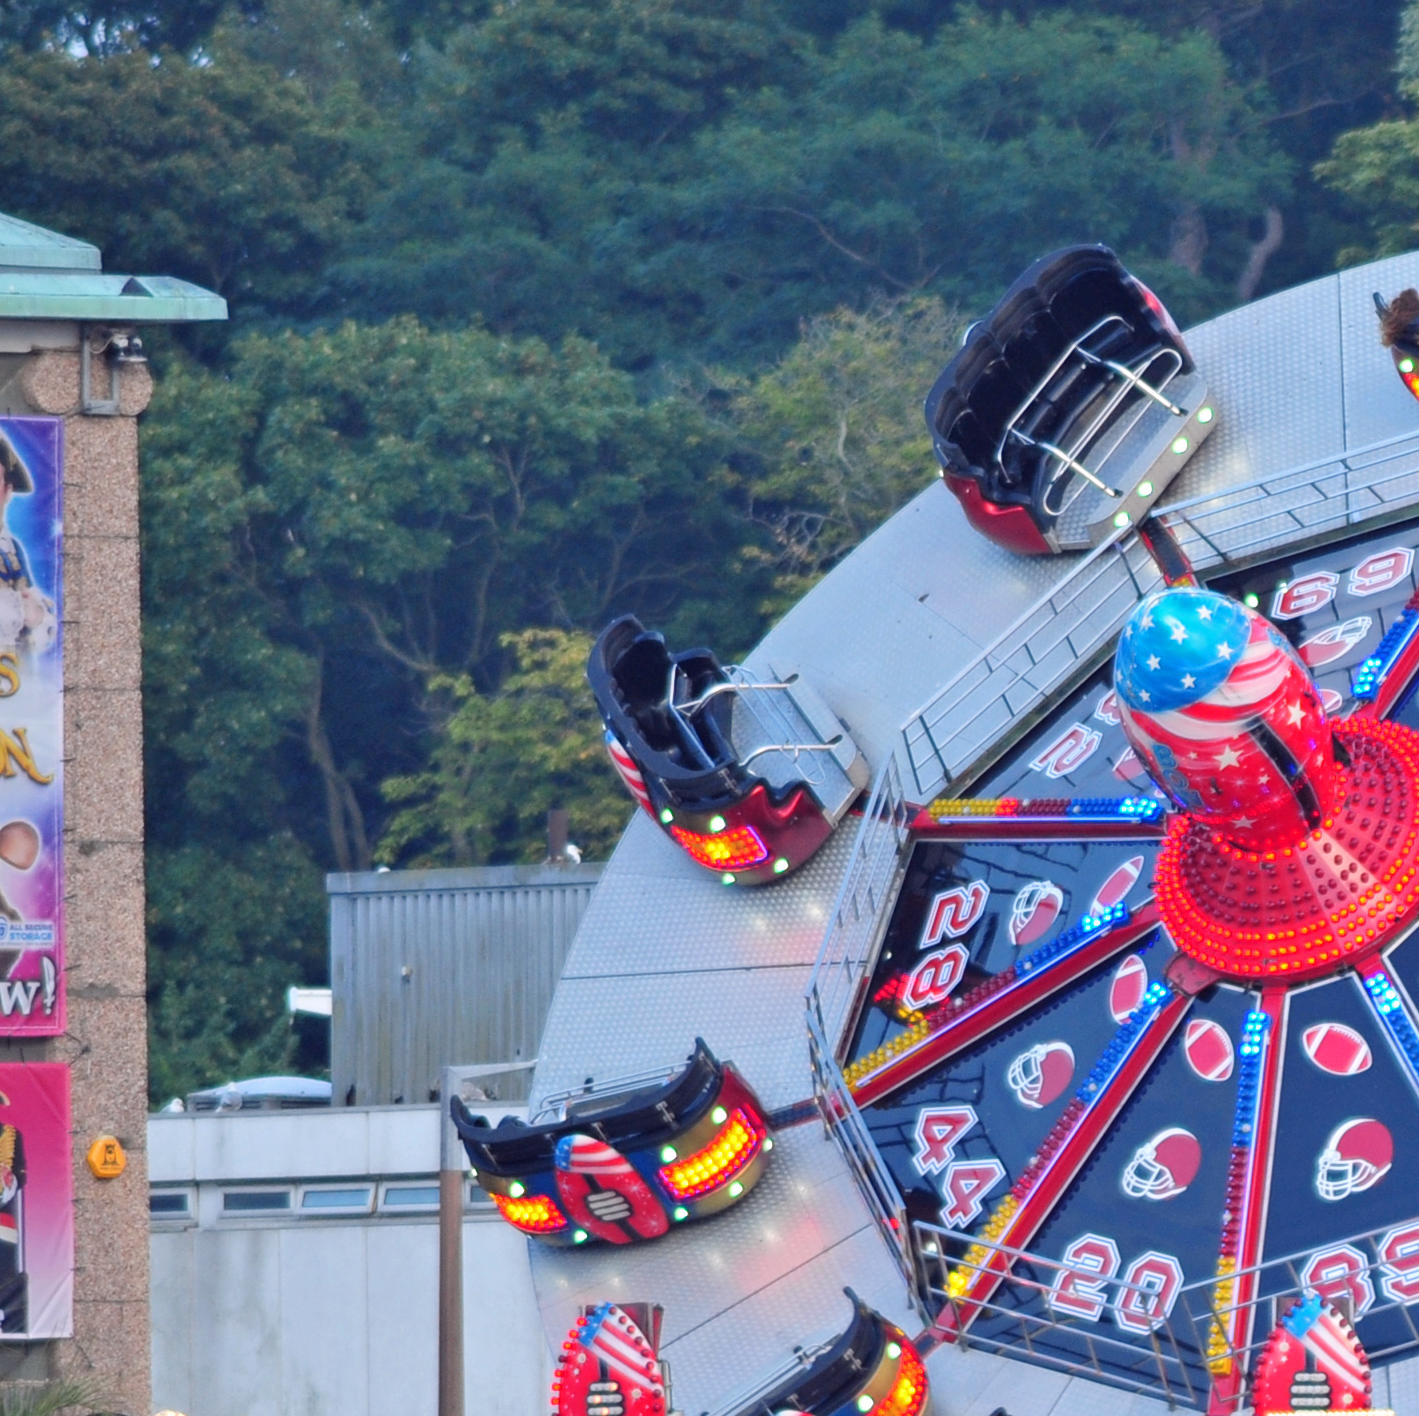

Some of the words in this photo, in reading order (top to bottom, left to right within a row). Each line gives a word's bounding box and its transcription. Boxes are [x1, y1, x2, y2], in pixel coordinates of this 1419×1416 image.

[903, 880, 990, 1009] 28
[912, 1105, 1006, 1230] 44
[1049, 1232, 1185, 1335] 20
